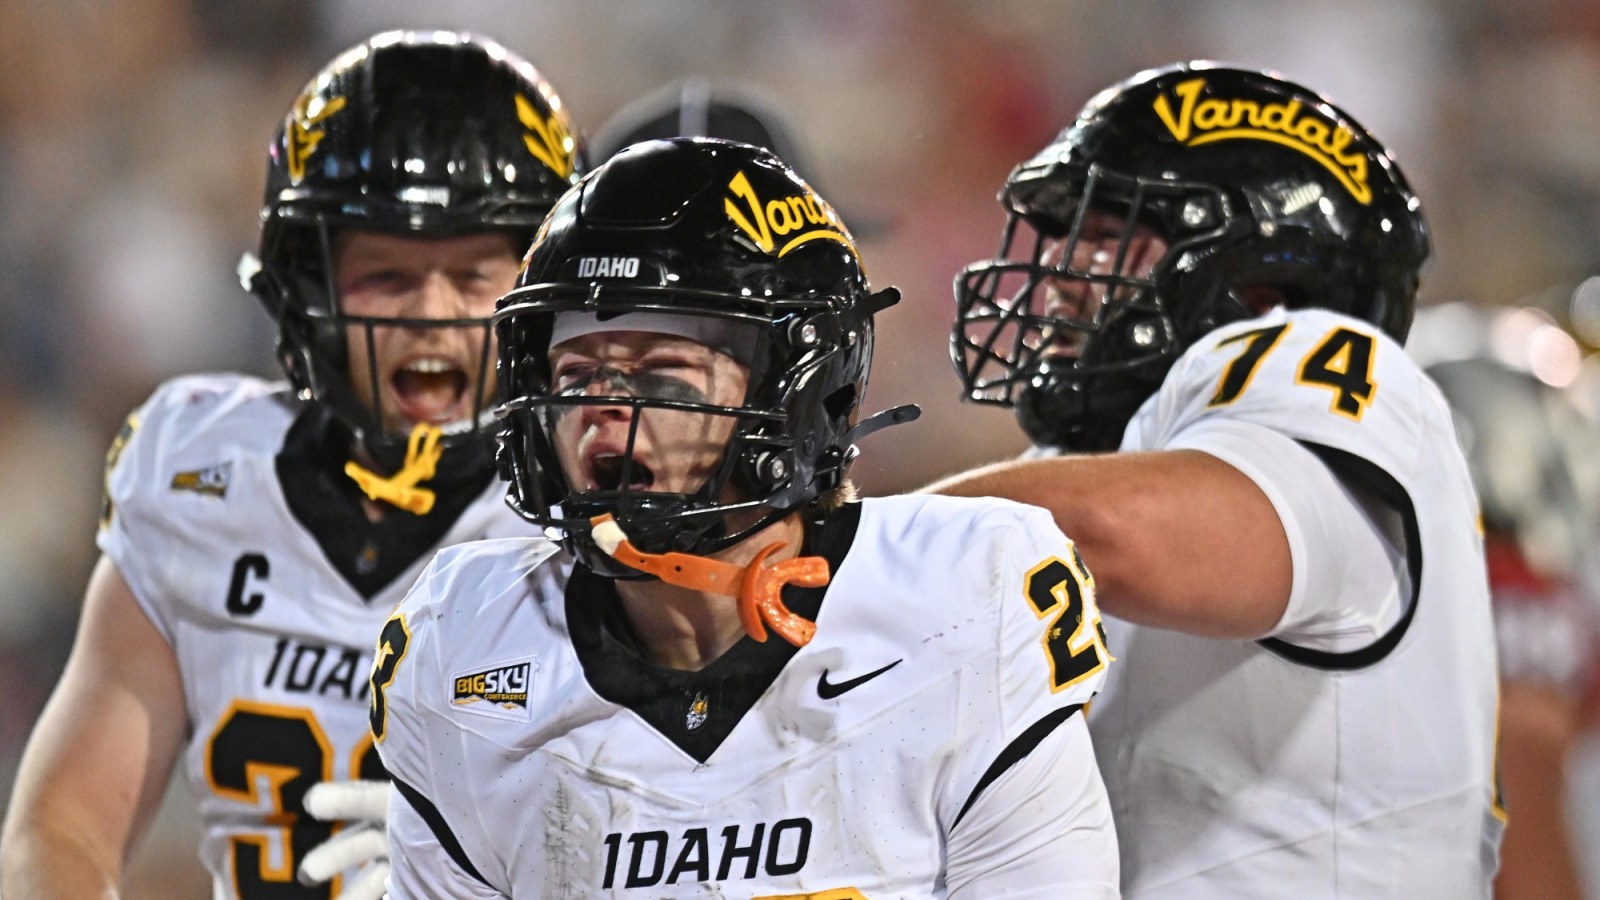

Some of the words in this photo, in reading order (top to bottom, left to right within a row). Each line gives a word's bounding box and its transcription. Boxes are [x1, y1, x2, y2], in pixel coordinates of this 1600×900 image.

[1153, 79, 1372, 188] Vandals
[577, 257, 640, 278] IDAHO
[1207, 322, 1377, 422] 74
[226, 553, 269, 616] C
[1023, 539, 1116, 694] 2
[264, 638, 373, 702] IDA
[602, 817, 812, 889] IDAHO
